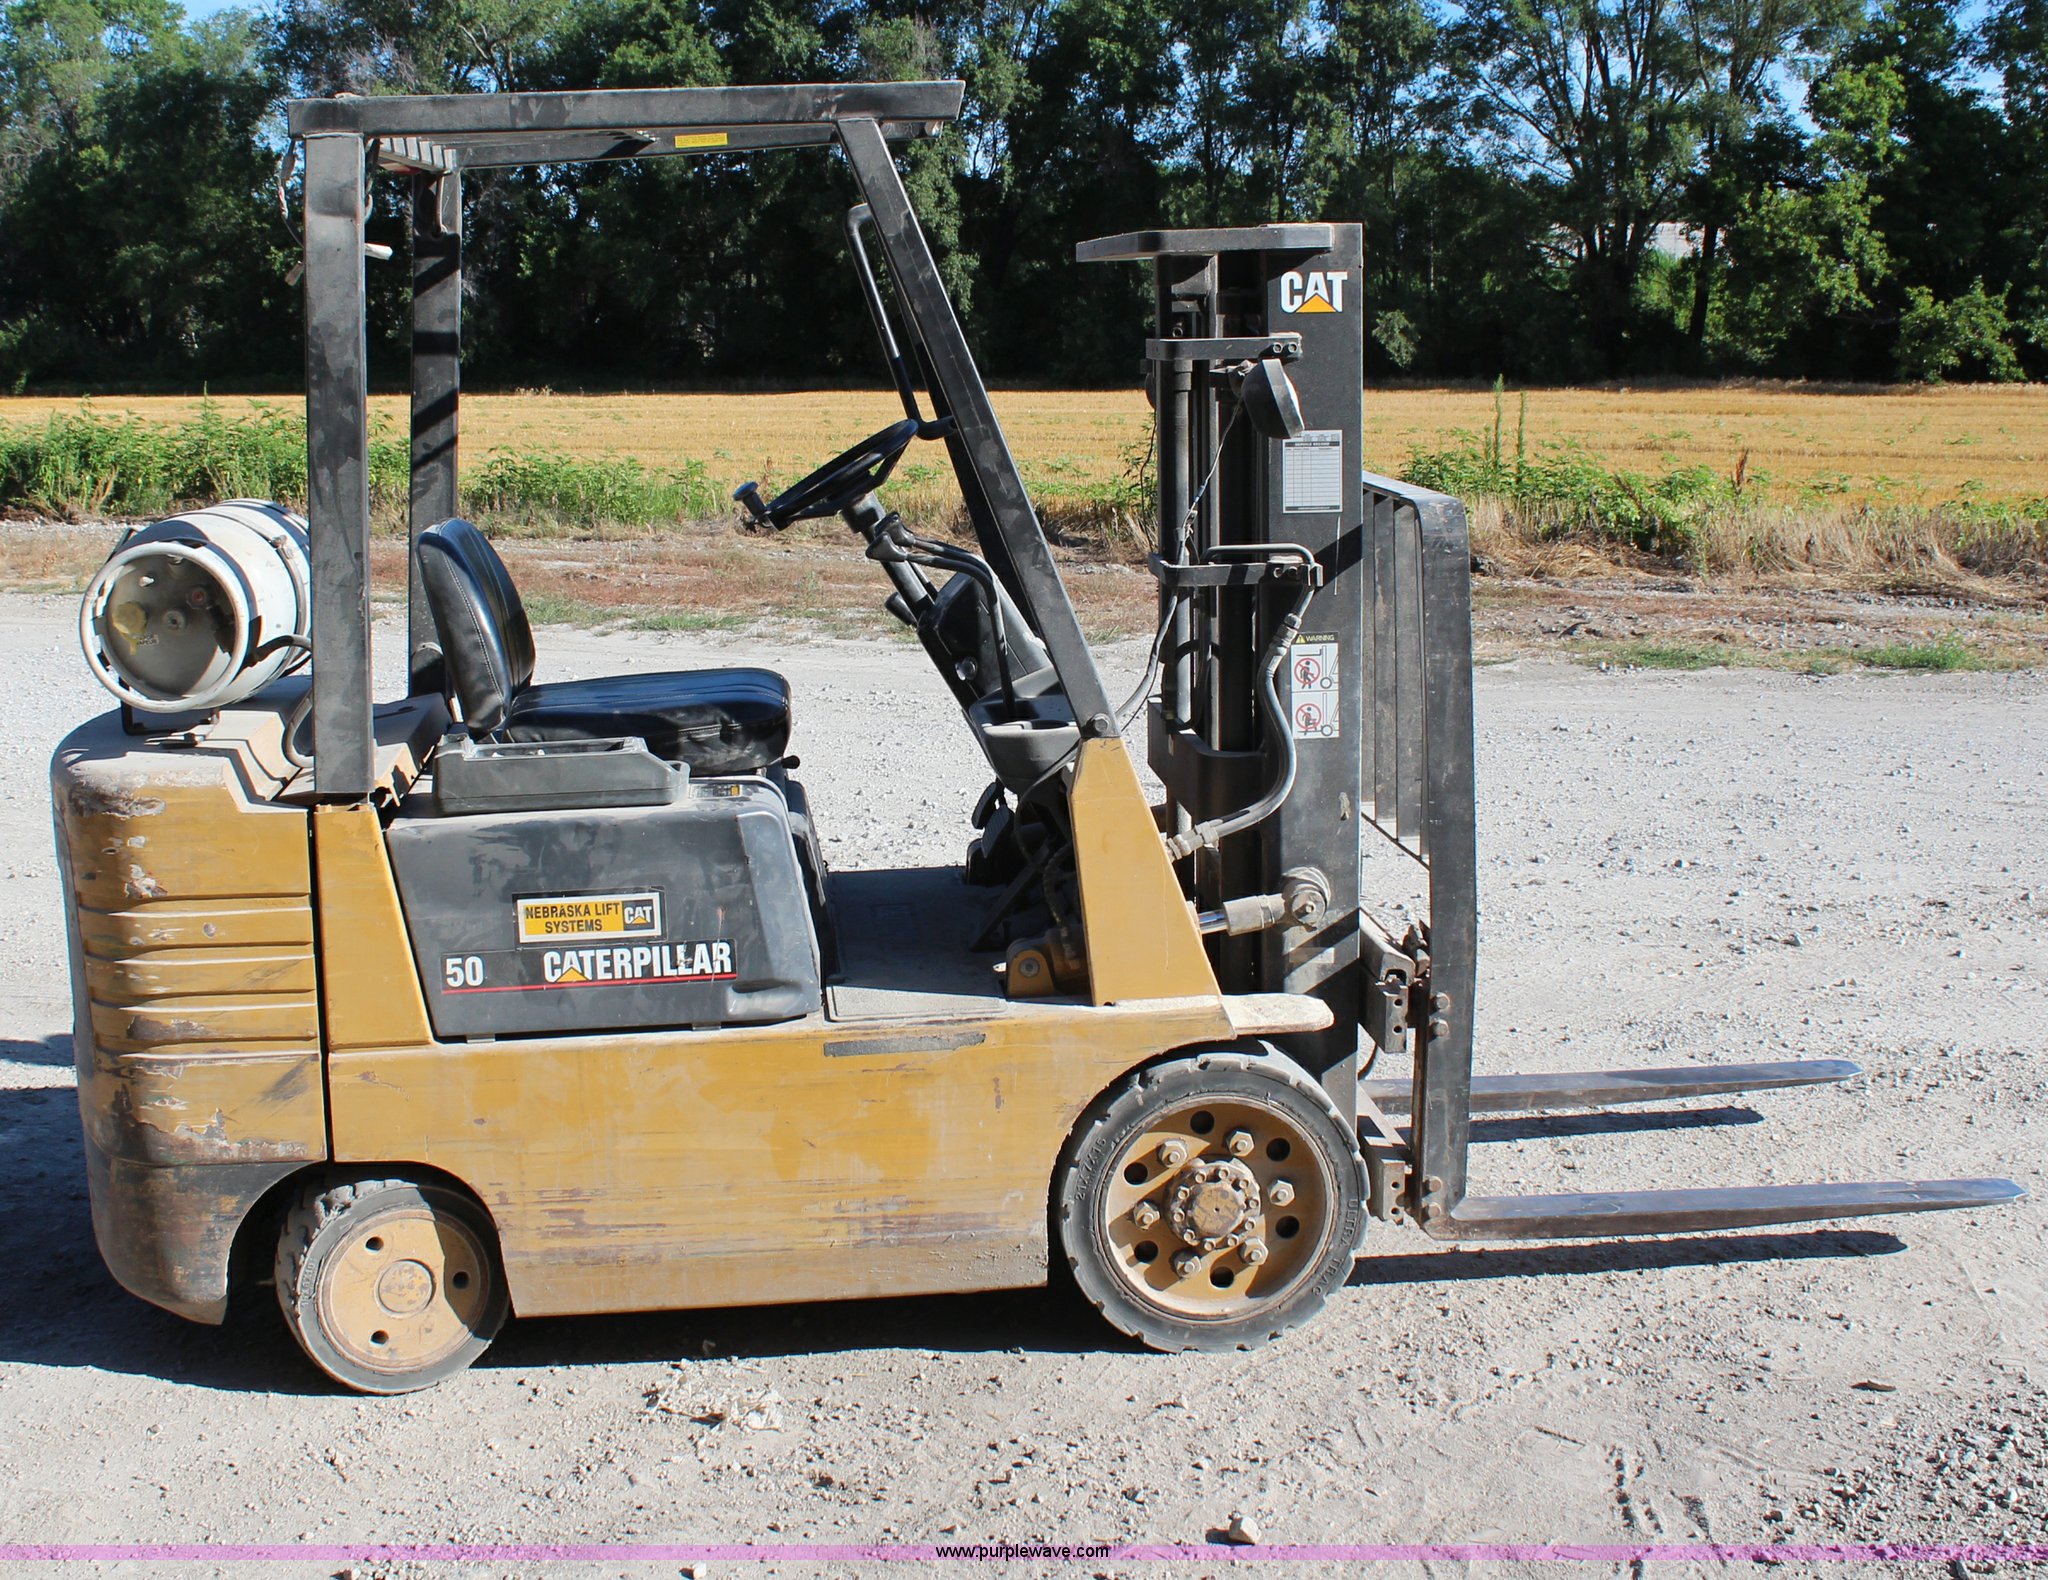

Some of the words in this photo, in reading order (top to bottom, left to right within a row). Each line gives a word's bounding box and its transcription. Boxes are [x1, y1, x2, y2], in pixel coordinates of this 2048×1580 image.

[1280, 271, 1348, 314] CAT
[1305, 634, 1335, 642] WARNING
[525, 904, 591, 919] NEBRASKA
[595, 902, 621, 916] LIFT
[545, 918, 603, 934] SYSTEMS
[624, 906, 653, 925] CAT
[445, 955, 485, 988] 50
[543, 942, 732, 984] CATERPILLAR
[1339, 1199, 1359, 1248] ULTRA
[1312, 1258, 1345, 1296] TRAC
